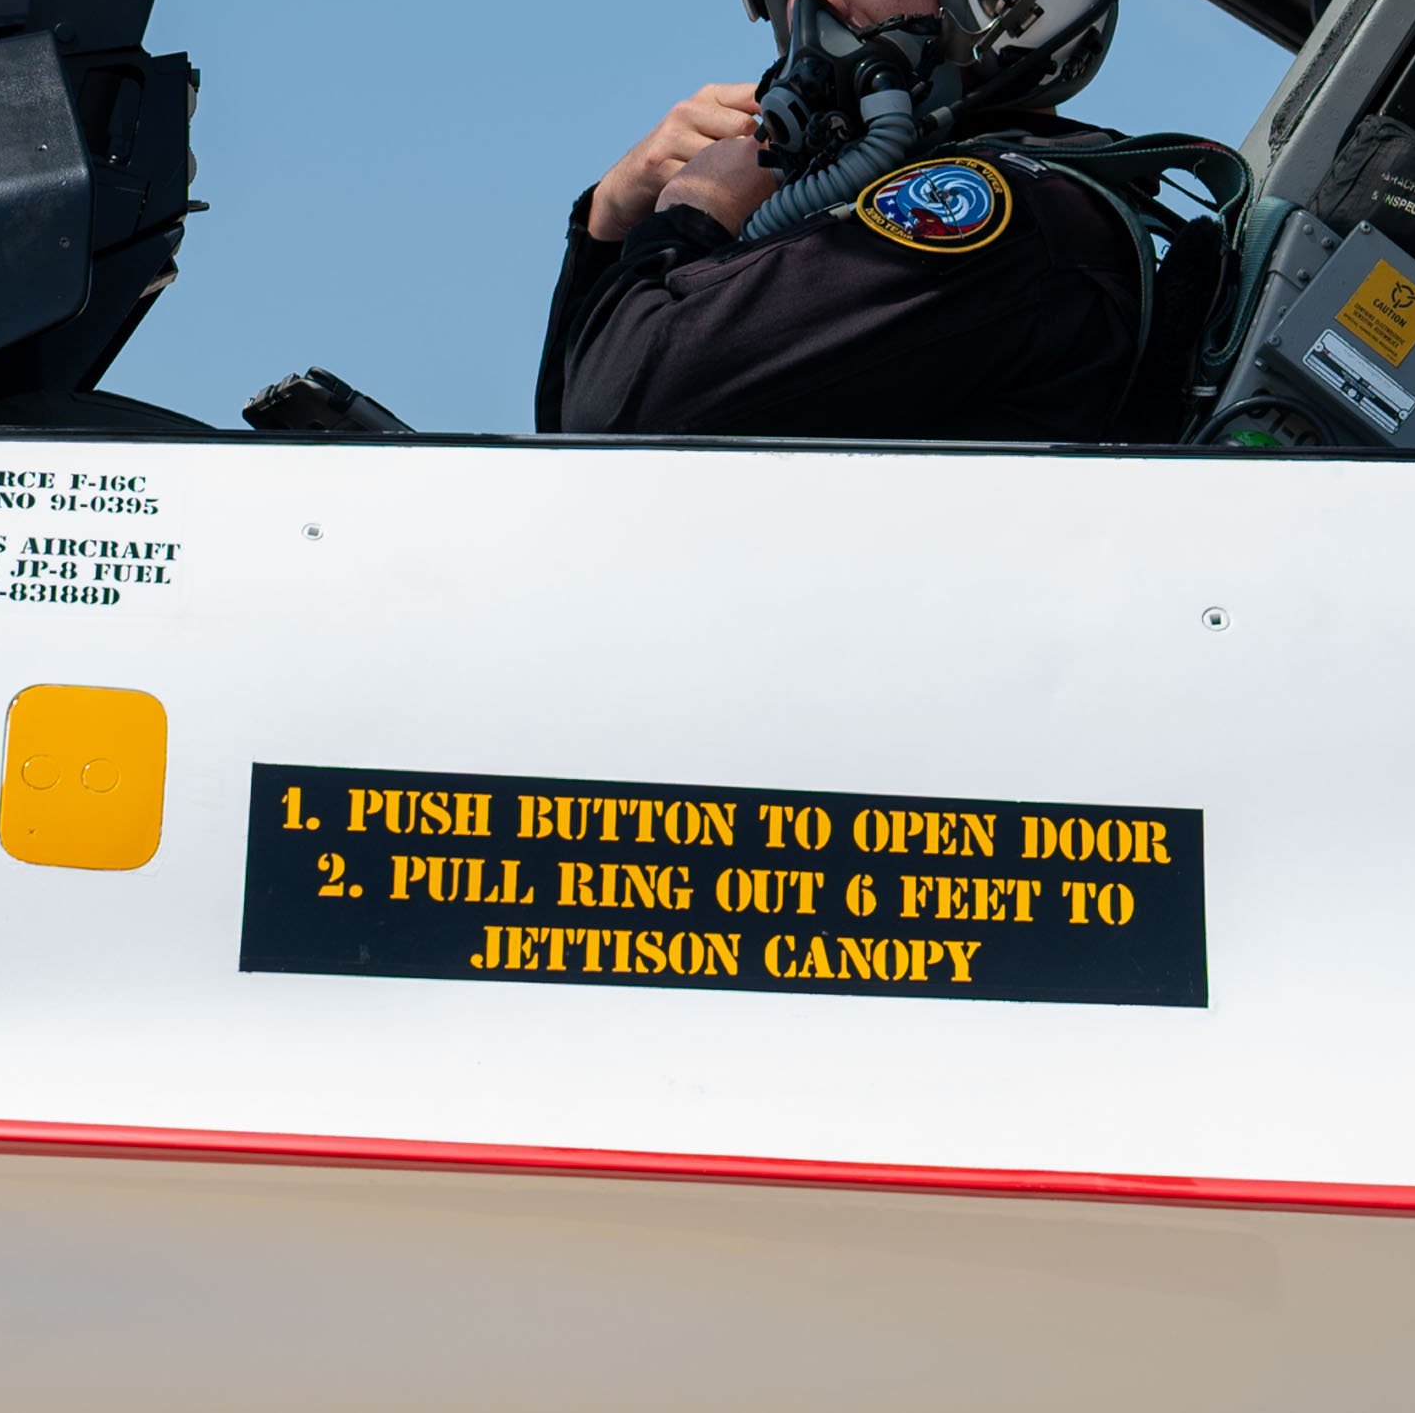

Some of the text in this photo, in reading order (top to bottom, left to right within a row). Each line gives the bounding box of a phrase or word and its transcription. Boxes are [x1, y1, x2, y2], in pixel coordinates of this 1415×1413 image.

[885, 222, 913, 240] TEAM
[1373, 298, 1407, 328] CAUTION
[70, 474, 146, 493] F-16C
[50, 494, 158, 515] 91-0395
[20, 537, 181, 561] AIRCRAFT
[10, 559, 77, 580] JP-8
[93, 563, 171, 584] FUEL
[282, 787, 1170, 864] 1. PUSH BUTTON TO OPEN DOOR
[318, 854, 1134, 925] 2. PULL RING OUT 6 FEET TO
[470, 926, 981, 982] JETTISON CANOPY
